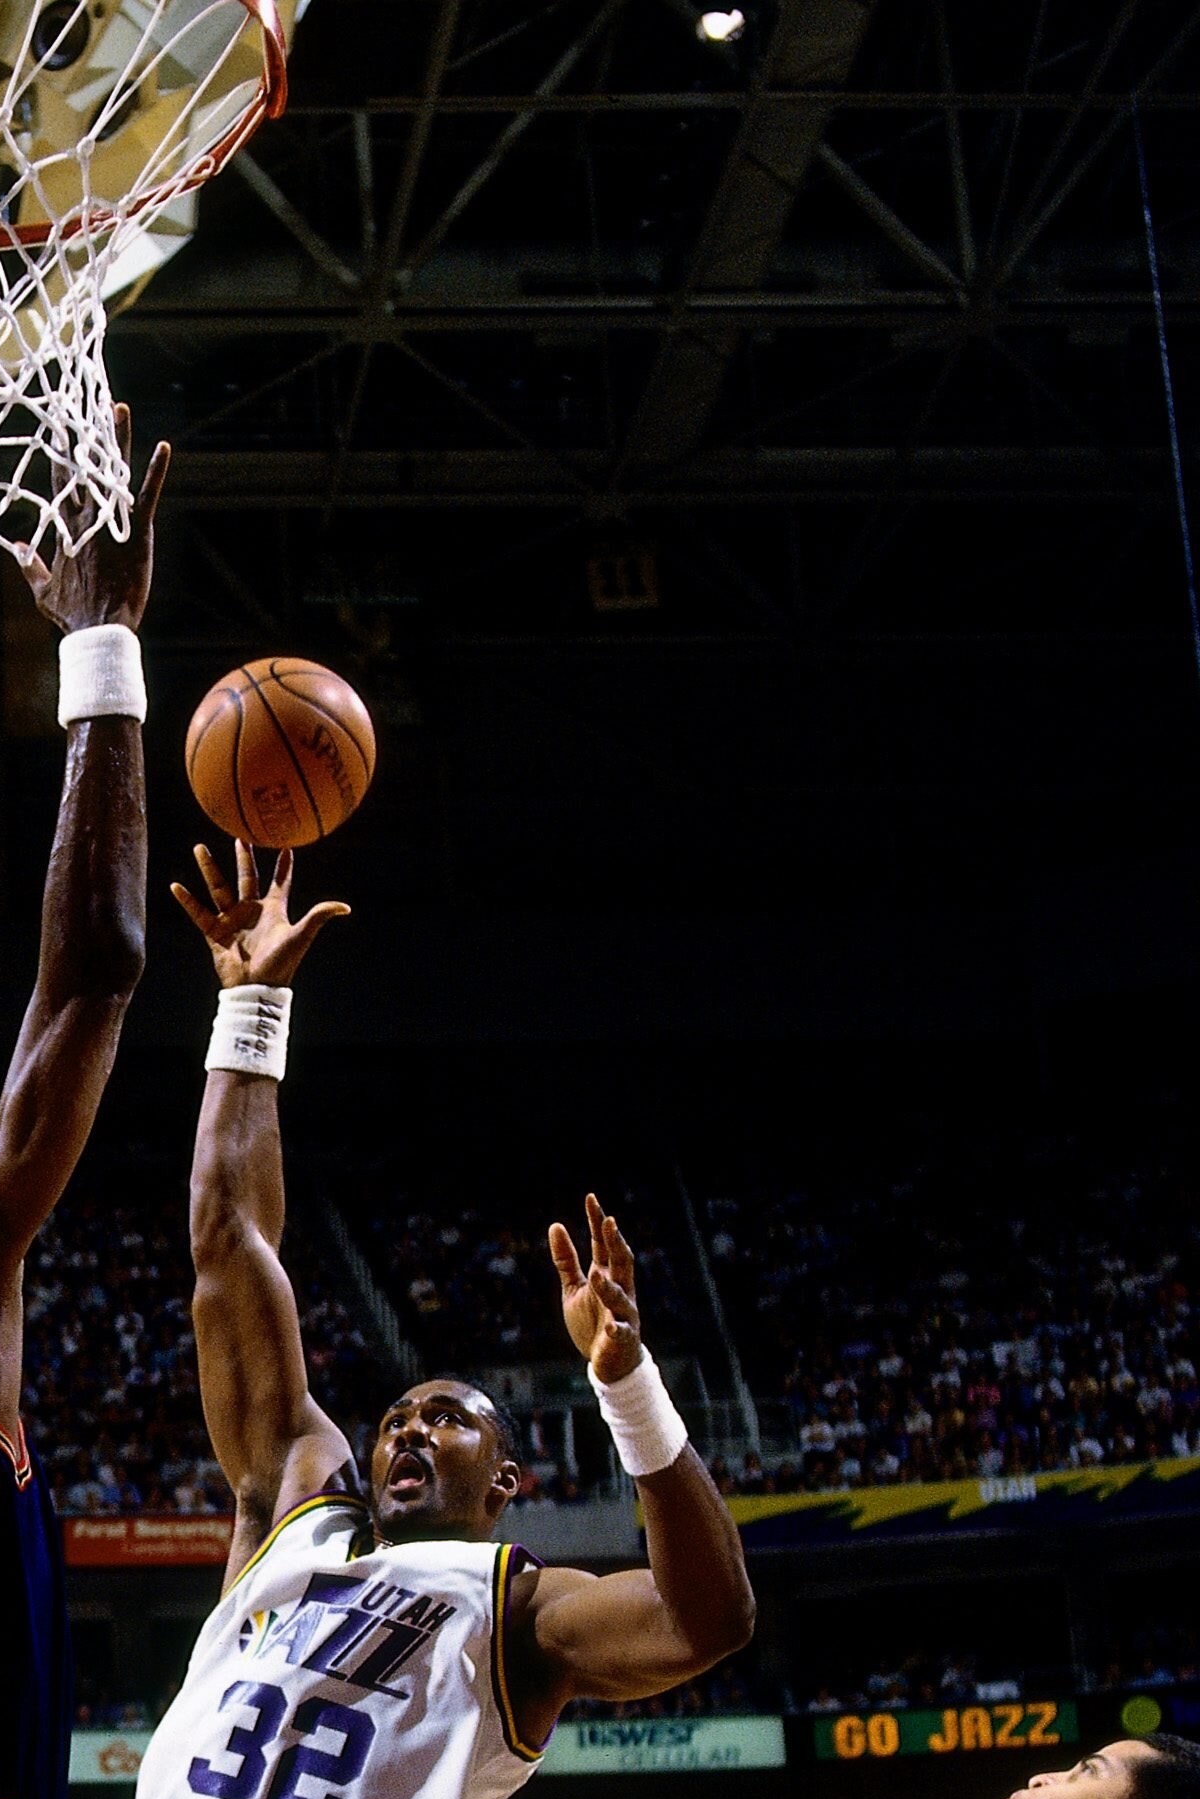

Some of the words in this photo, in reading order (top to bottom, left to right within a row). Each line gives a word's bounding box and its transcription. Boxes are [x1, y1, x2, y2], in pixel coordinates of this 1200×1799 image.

[360, 1581, 457, 1632] UTAH
[833, 1713, 899, 1759] GO
[928, 1701, 1061, 1755] JAZZ
